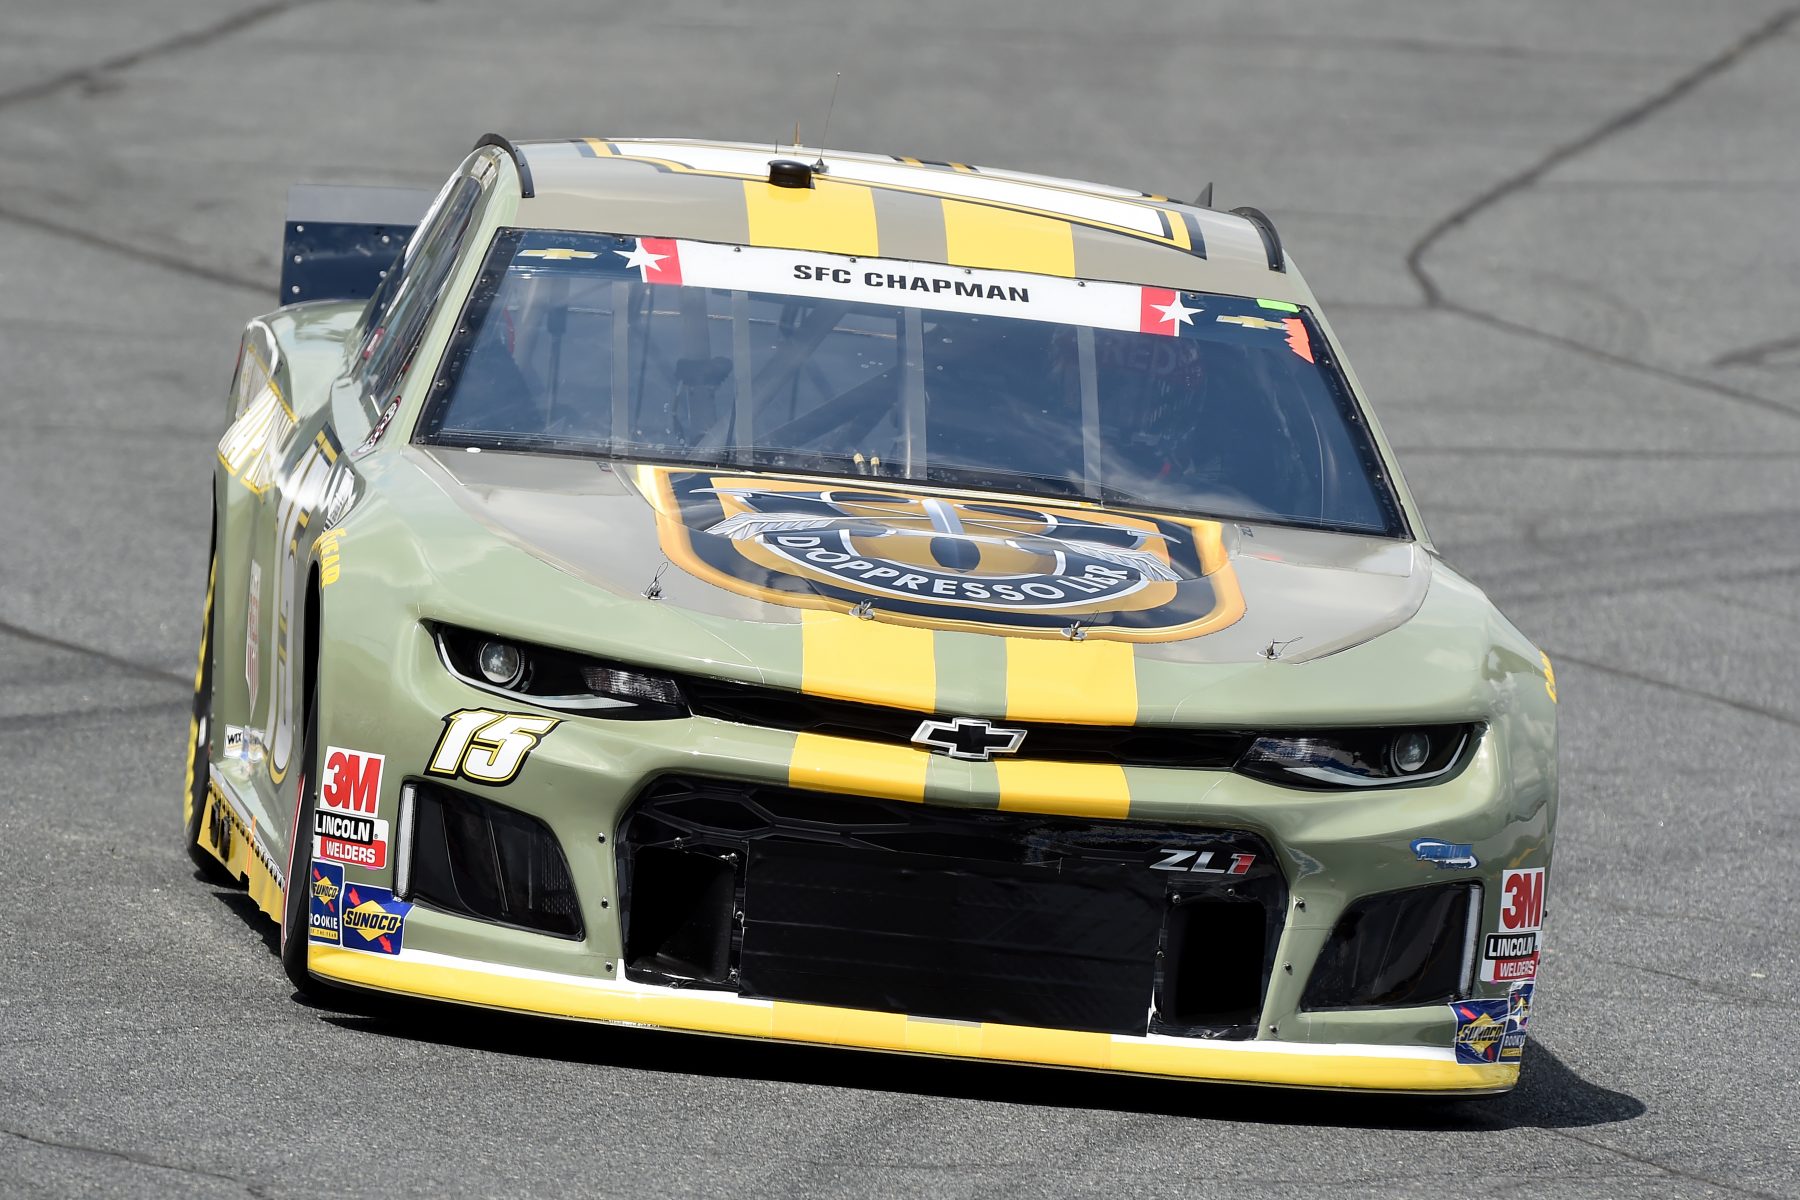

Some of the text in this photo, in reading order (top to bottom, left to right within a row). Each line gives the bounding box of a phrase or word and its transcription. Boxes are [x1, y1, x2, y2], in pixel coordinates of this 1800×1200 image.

[793, 264, 1029, 303] SFC CHAPMAN
[805, 551, 1065, 602] OPPRESSO
[424, 708, 561, 786] 15
[323, 751, 382, 814] 3M
[315, 813, 371, 842] LINCOLN
[326, 841, 376, 864] WELDERS
[1150, 848, 1256, 875] ZL1
[313, 883, 337, 898] SUNOCO
[1502, 871, 1544, 930] 3M
[345, 910, 399, 932] SUNOCO
[1488, 936, 1534, 957] LINCOLN
[1499, 960, 1534, 977] WELDERS
[1460, 1025, 1503, 1042] SUNOCO
